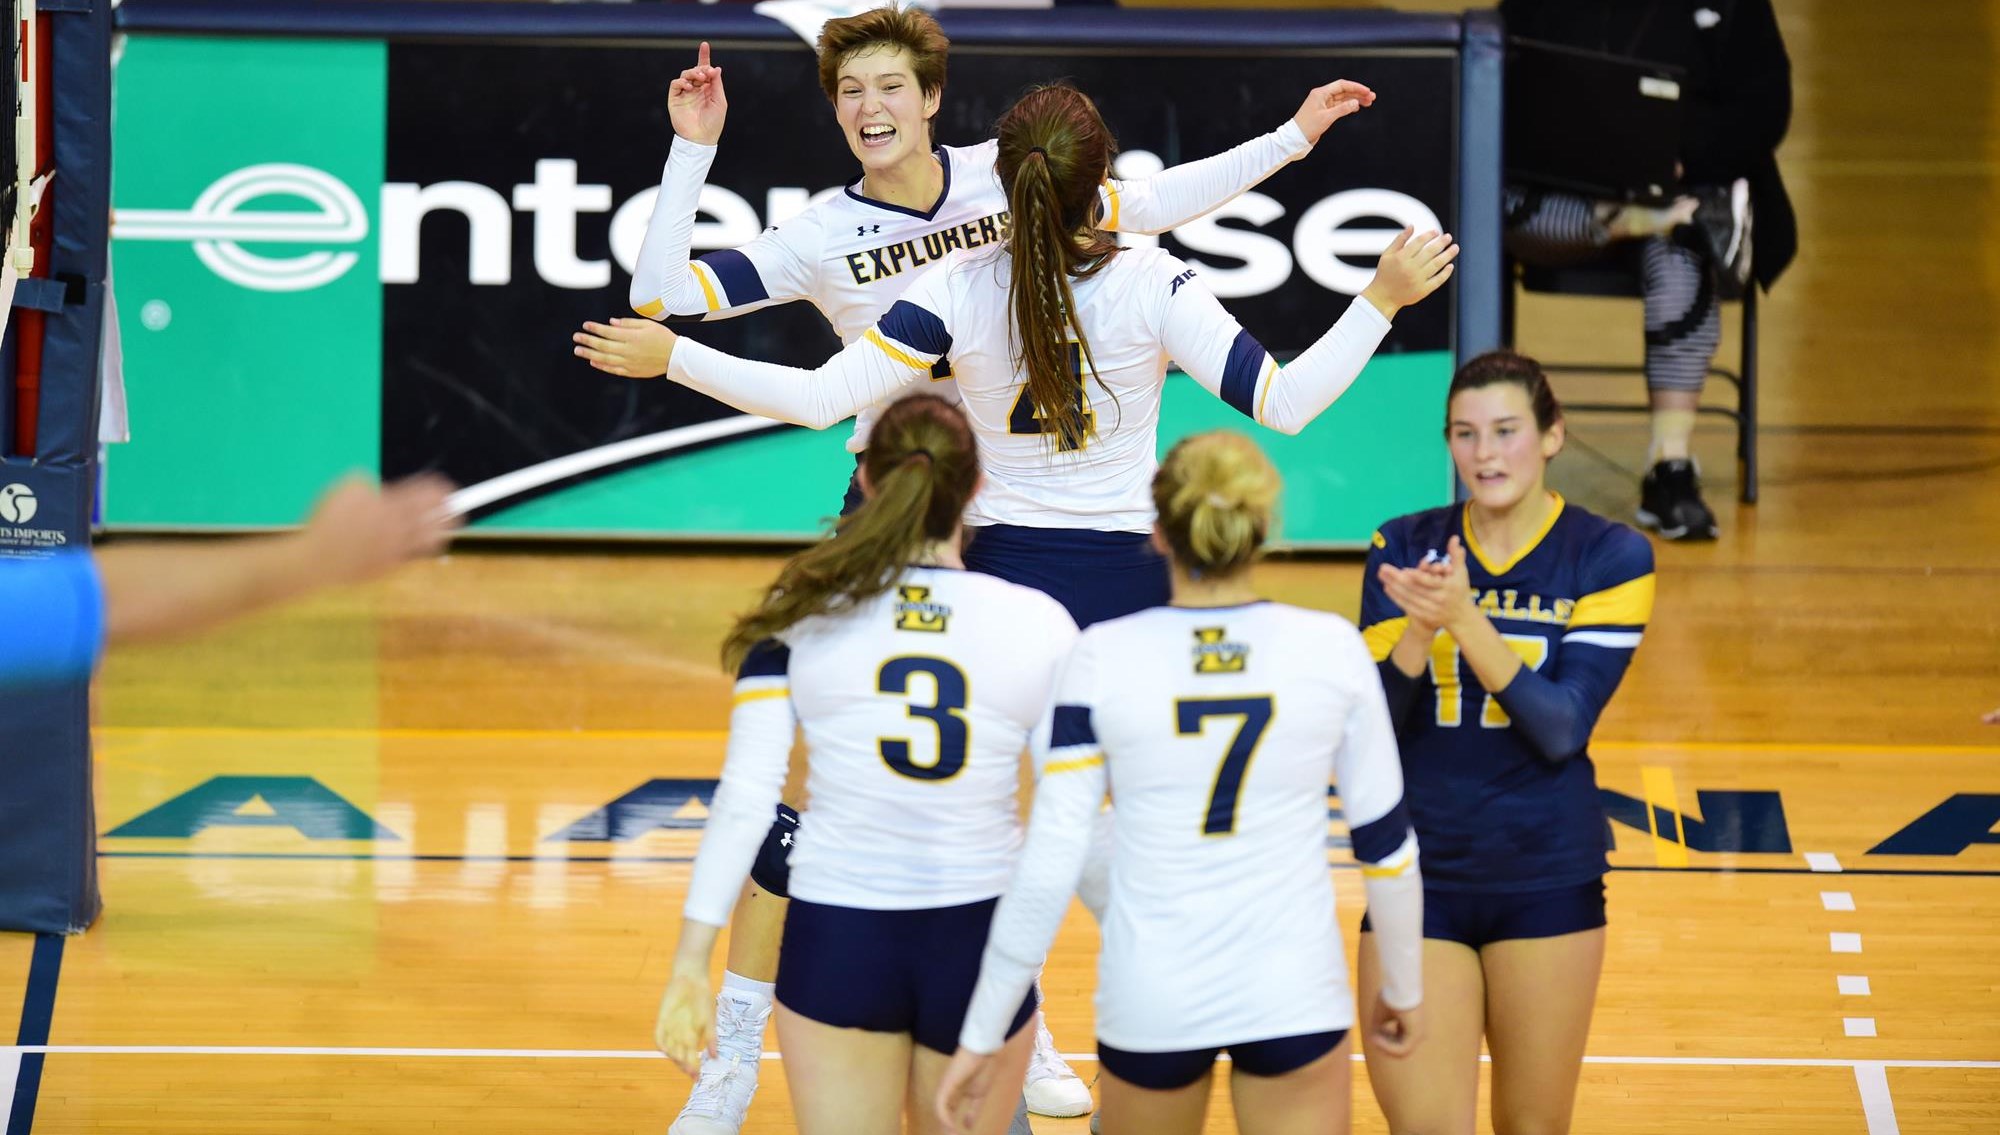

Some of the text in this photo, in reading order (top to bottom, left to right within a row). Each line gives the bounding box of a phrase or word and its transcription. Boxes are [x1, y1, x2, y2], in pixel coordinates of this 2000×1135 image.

[112, 150, 1443, 298] entese
[14, 528, 67, 545] IMPORTS
[1470, 588, 1577, 625] ALLE
[876, 654, 970, 782] 3
[1174, 694, 1275, 836] 7
